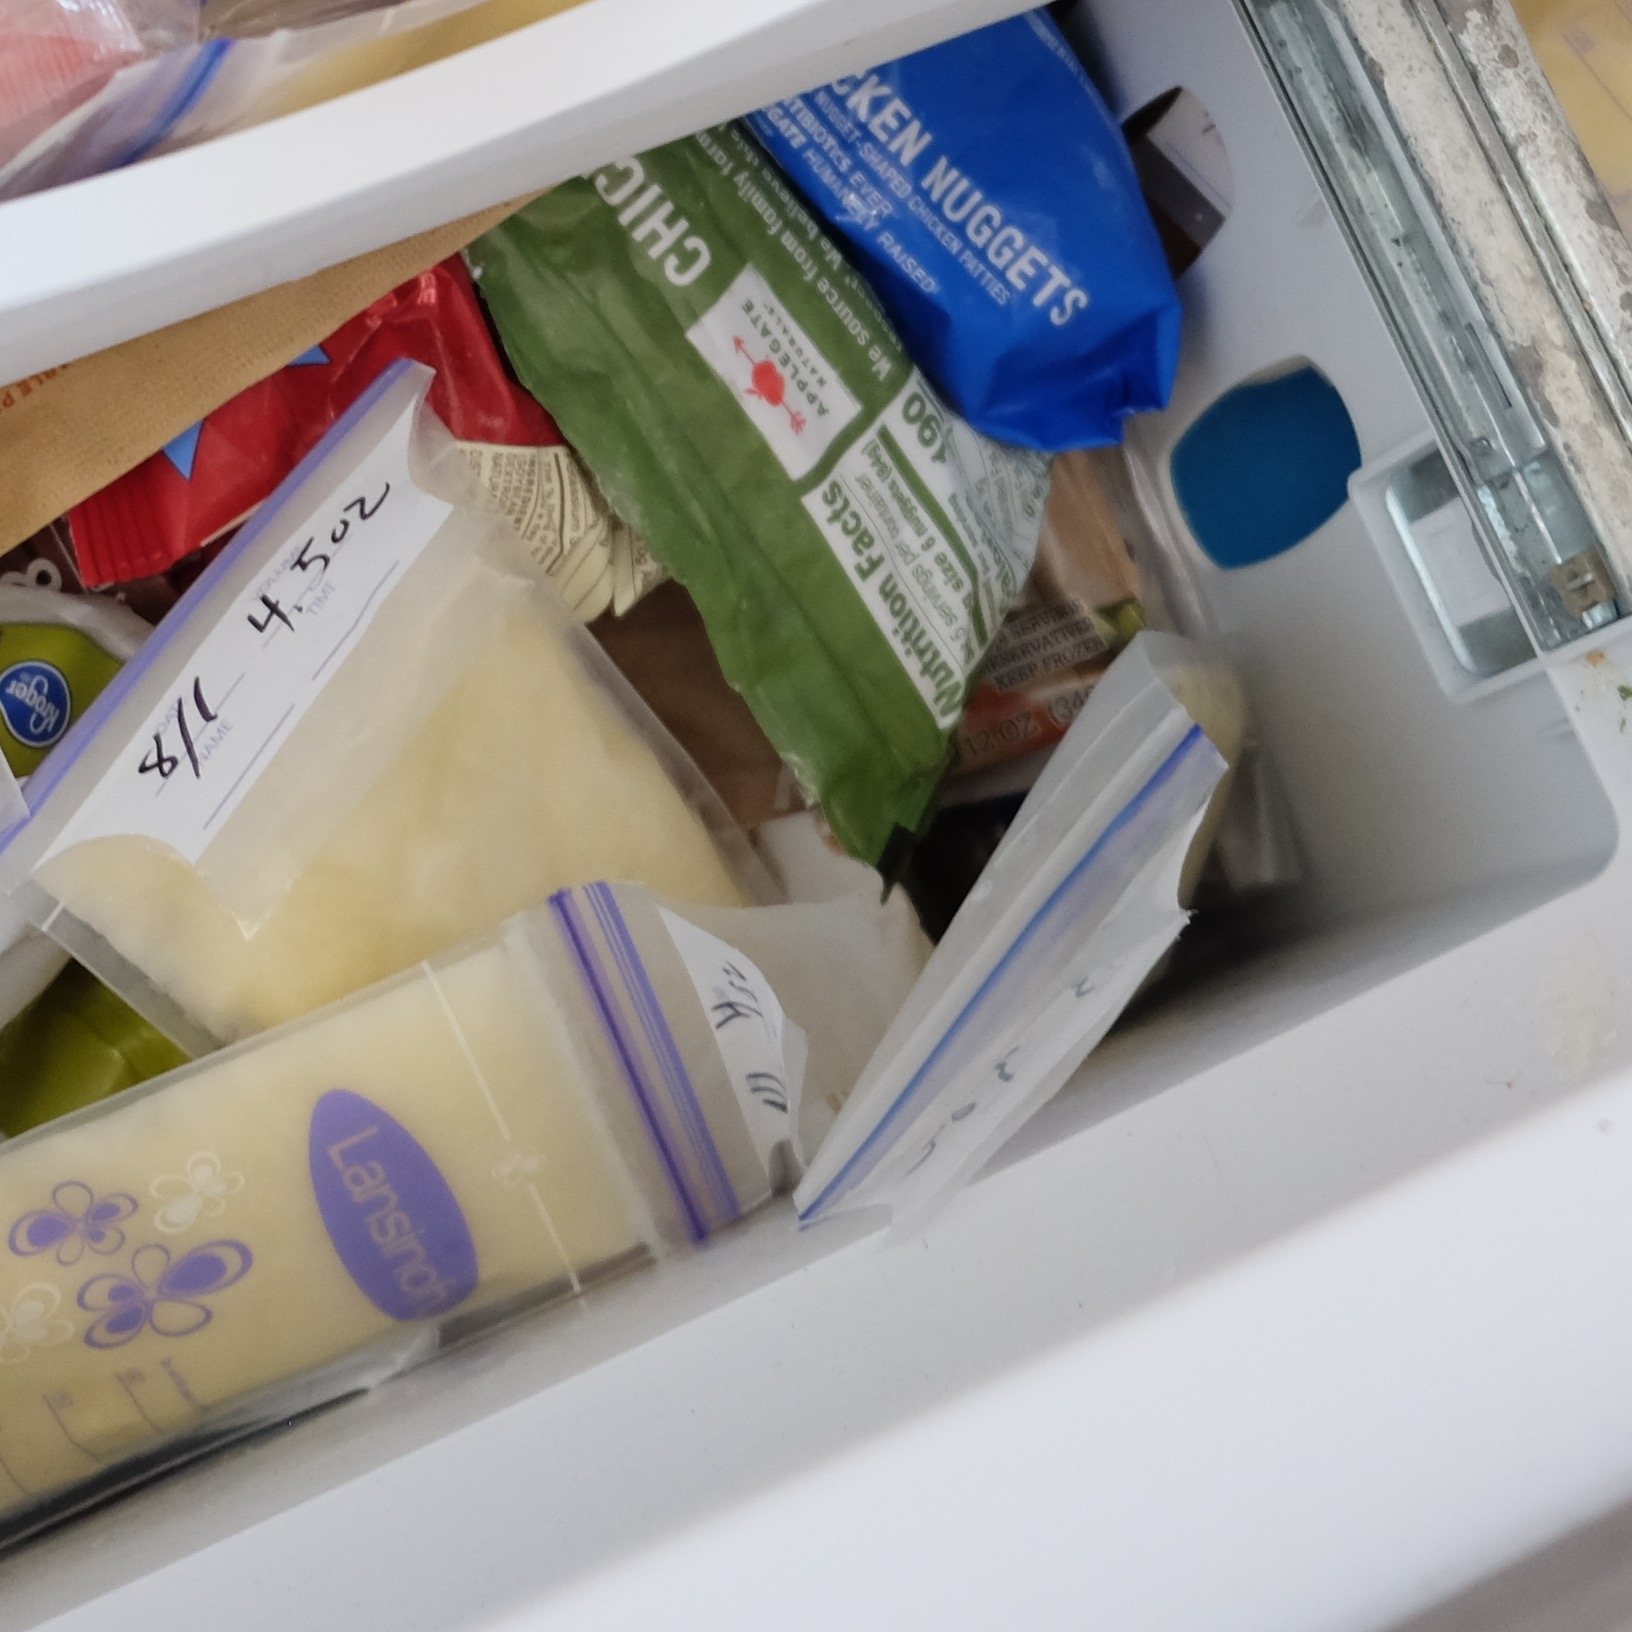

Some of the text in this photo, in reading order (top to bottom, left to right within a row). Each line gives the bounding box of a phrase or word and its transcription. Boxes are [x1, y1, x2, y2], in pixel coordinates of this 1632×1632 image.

[733, 170, 784, 237] family
[920, 155, 1090, 328] NUGGETS
[780, 229, 819, 282] from
[908, 194, 966, 257] CHICKEN
[958, 243, 1012, 309] PATTIES
[817, 277, 871, 347] source
[740, 298, 831, 417] APPLEGATE
[868, 342, 893, 383] We
[900, 390, 948, 466] 190
[307, 579, 338, 617] TIME
[821, 480, 965, 718] Nutrition Facts
[911, 559, 960, 636] servings
[5, 674, 61, 734] Kroger
[326, 1124, 452, 1323] Lansinoh
